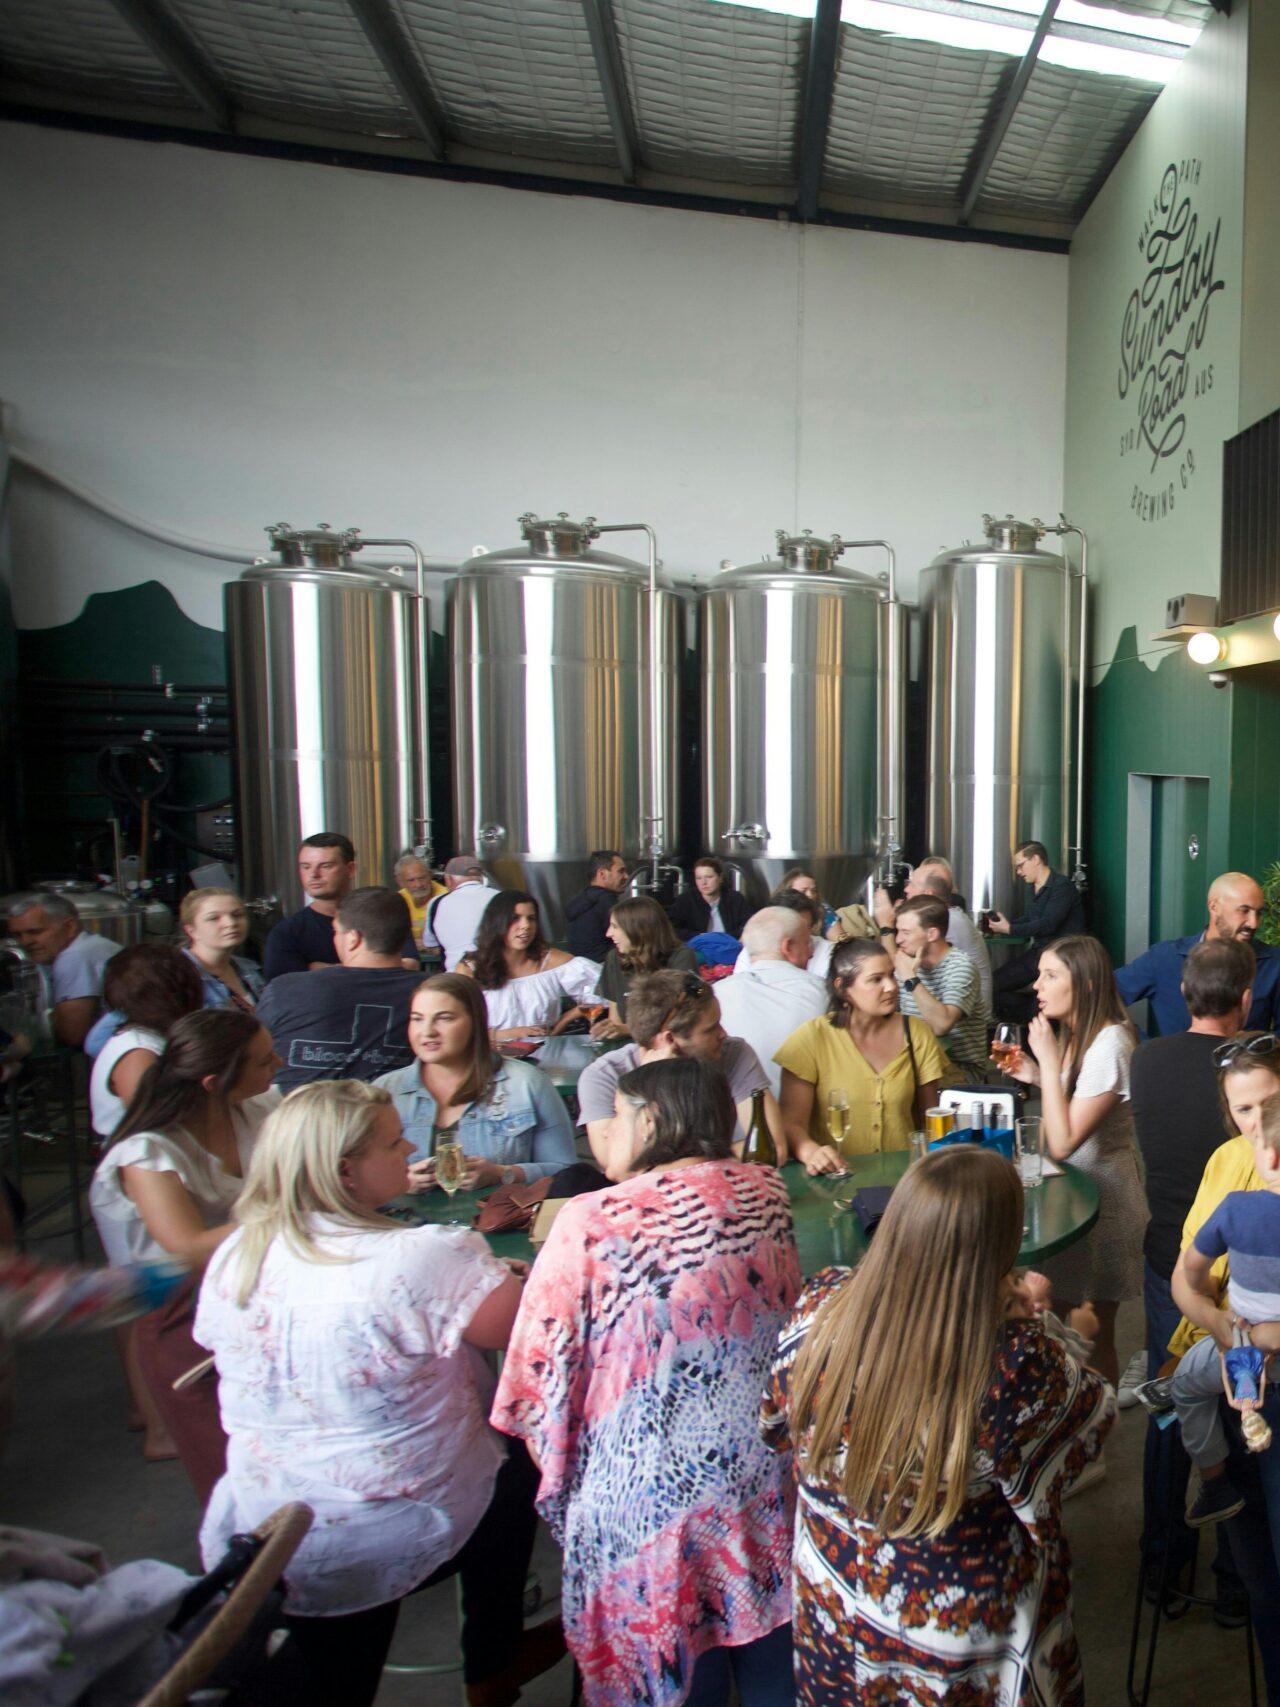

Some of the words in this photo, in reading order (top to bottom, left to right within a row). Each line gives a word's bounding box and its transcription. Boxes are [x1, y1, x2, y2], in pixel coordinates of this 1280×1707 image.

[1137, 194, 1159, 254] WALK
[1178, 158, 1202, 185] PATH
[1118, 180, 1225, 400] Sunday
[1137, 340, 1193, 474] Road
[1195, 363, 1214, 399] AUS
[1130, 482, 1175, 522] BREWING
